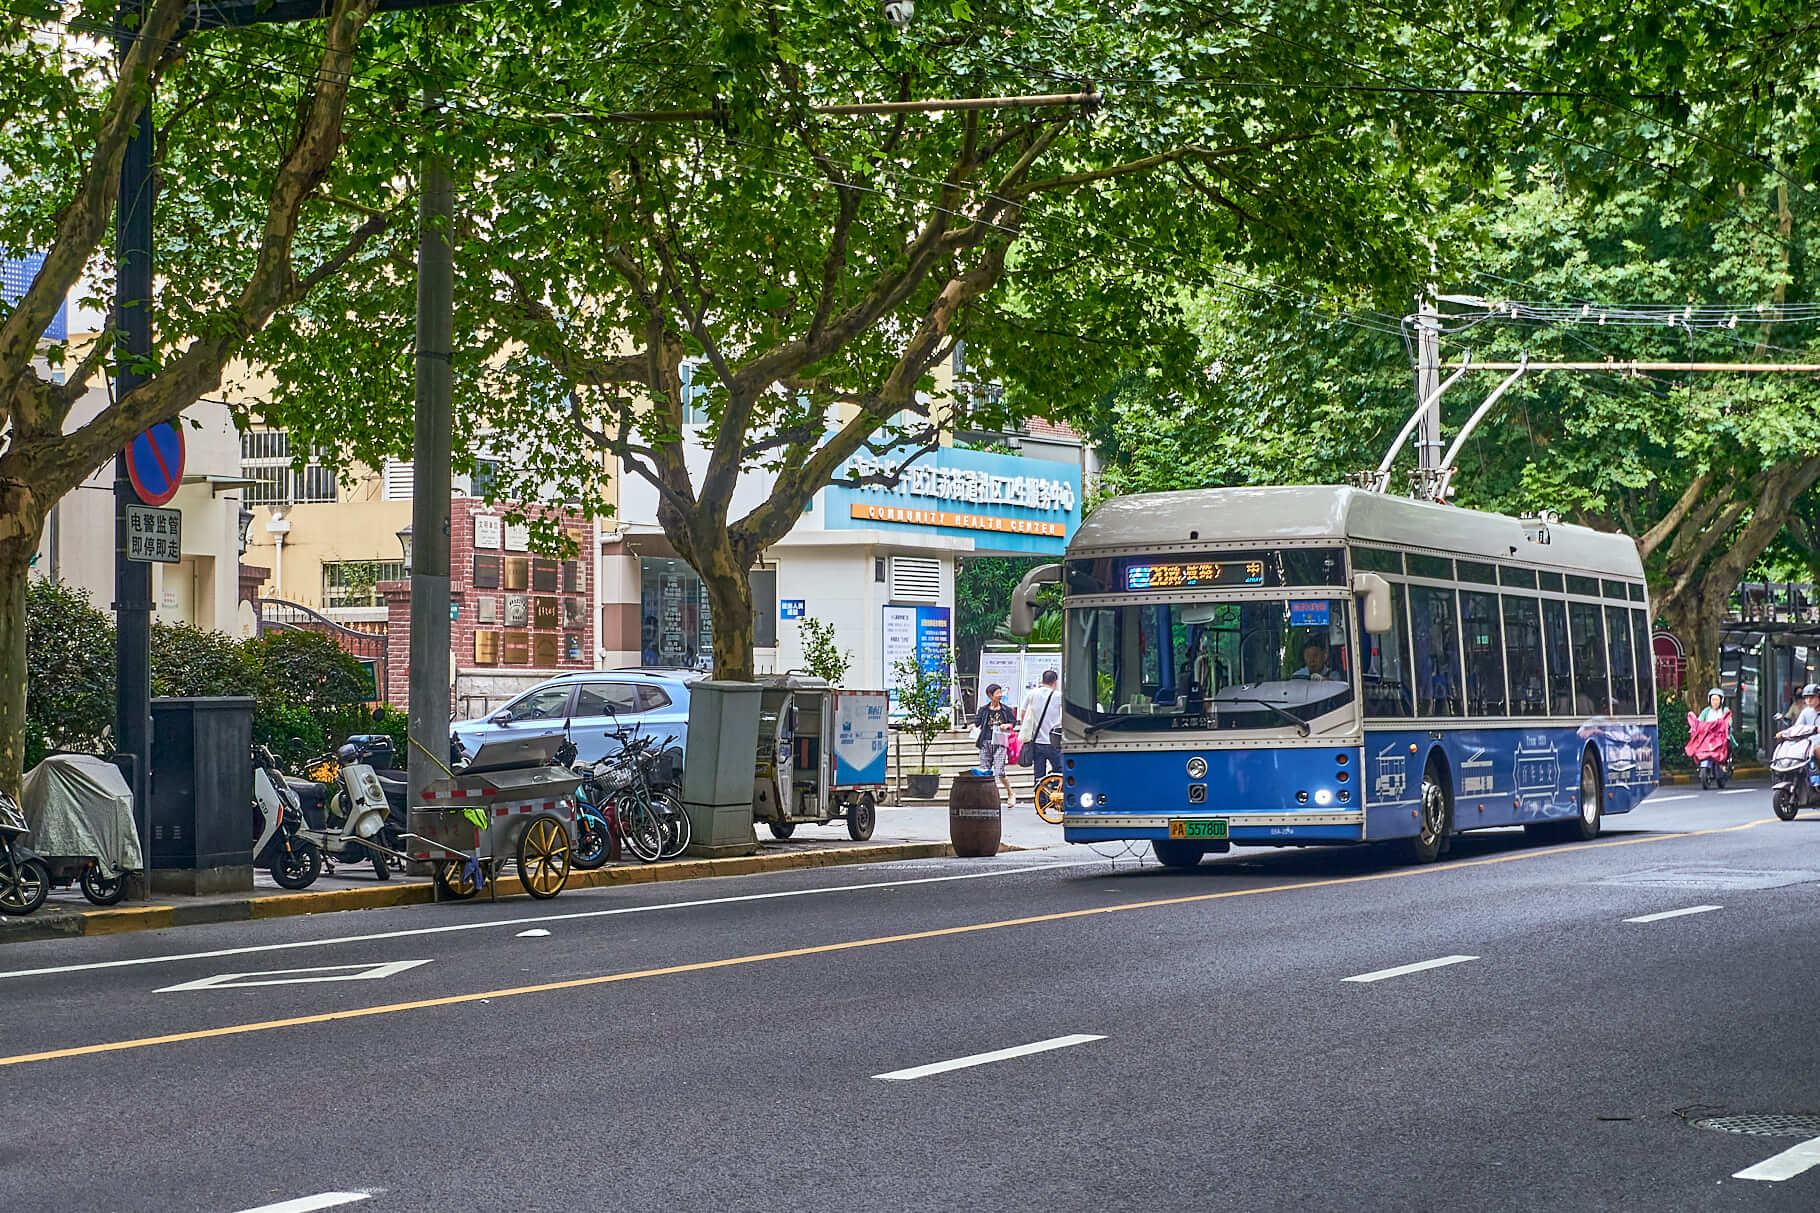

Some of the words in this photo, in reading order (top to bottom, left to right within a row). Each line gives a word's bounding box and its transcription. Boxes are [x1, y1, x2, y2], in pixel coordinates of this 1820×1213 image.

[130, 512, 178, 535] 电警监管
[868, 506, 945, 525] COMMUNITY
[955, 515, 1003, 530] HEALTH
[1010, 520, 1056, 536] CENTER
[131, 536, 179, 558] 即停即走
